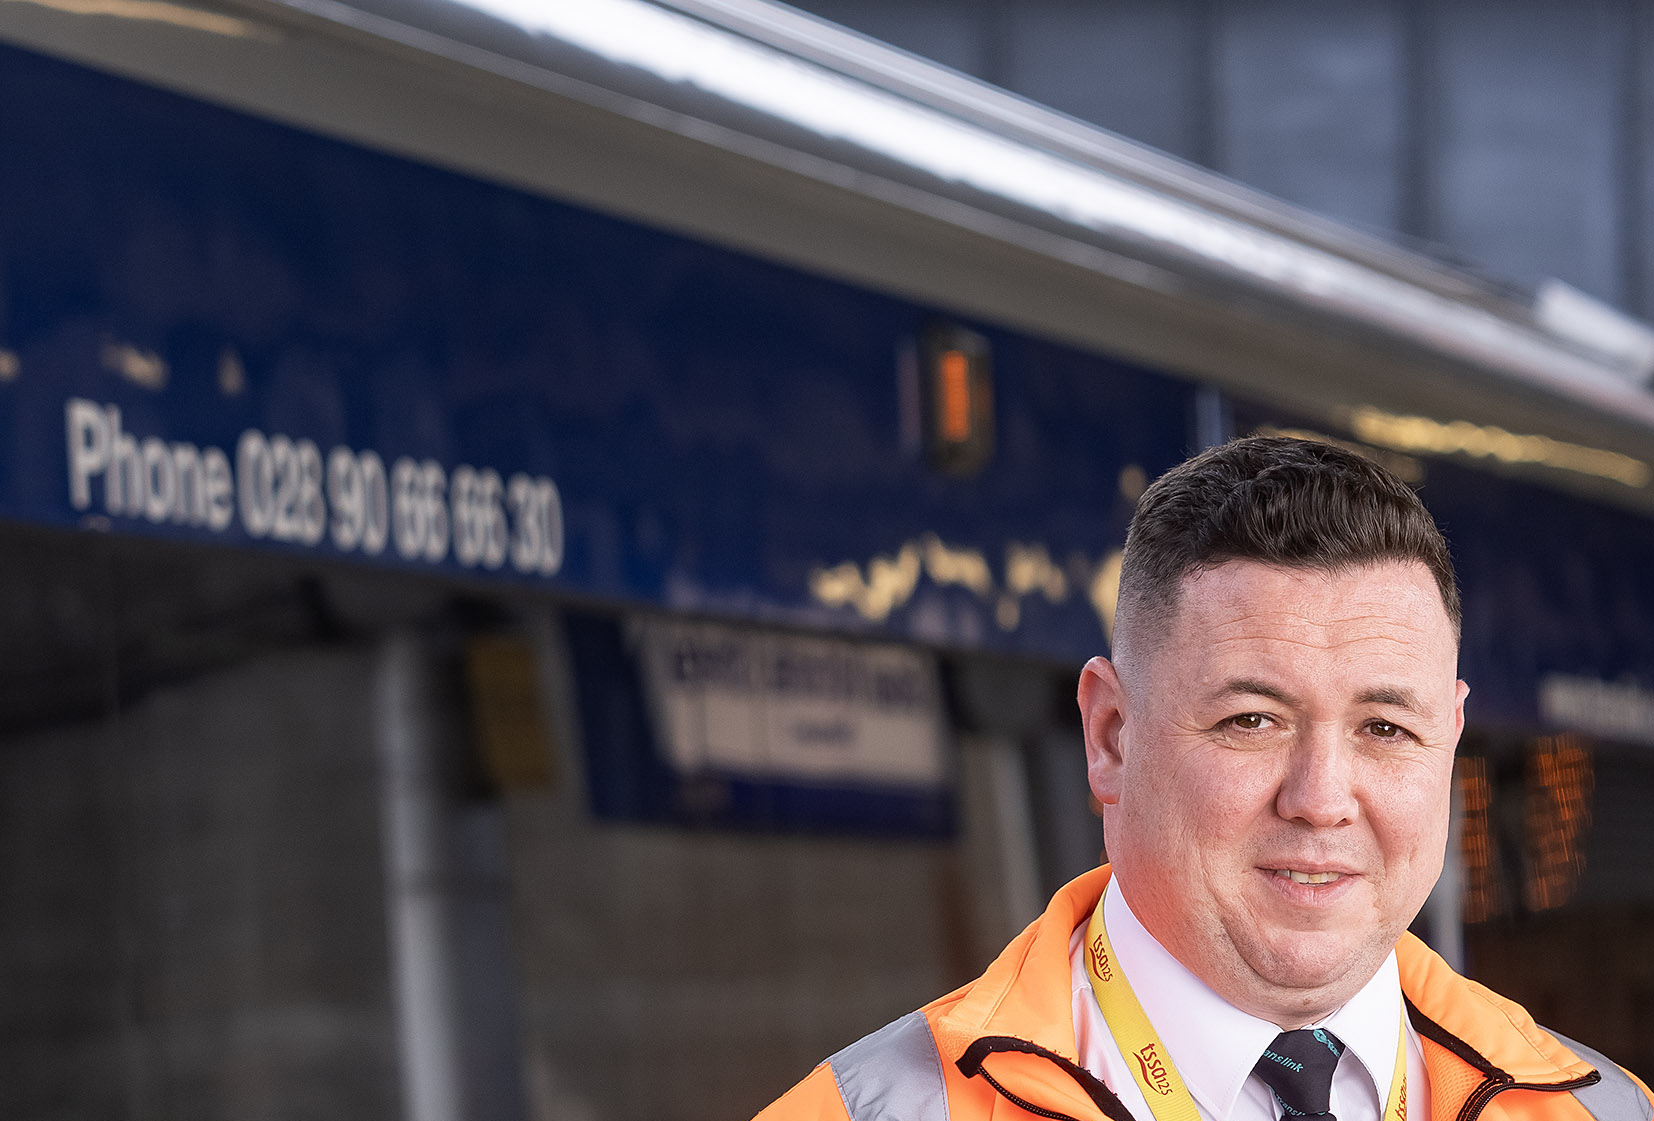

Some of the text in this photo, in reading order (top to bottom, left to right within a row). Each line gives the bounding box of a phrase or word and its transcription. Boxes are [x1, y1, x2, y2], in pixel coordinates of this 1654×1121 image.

[66, 398, 234, 532] Phone
[236, 428, 327, 547] 028
[327, 445, 391, 555] 90
[391, 456, 450, 563] 66
[507, 472, 565, 578] 30
[1140, 1043, 1173, 1096] tssa125
